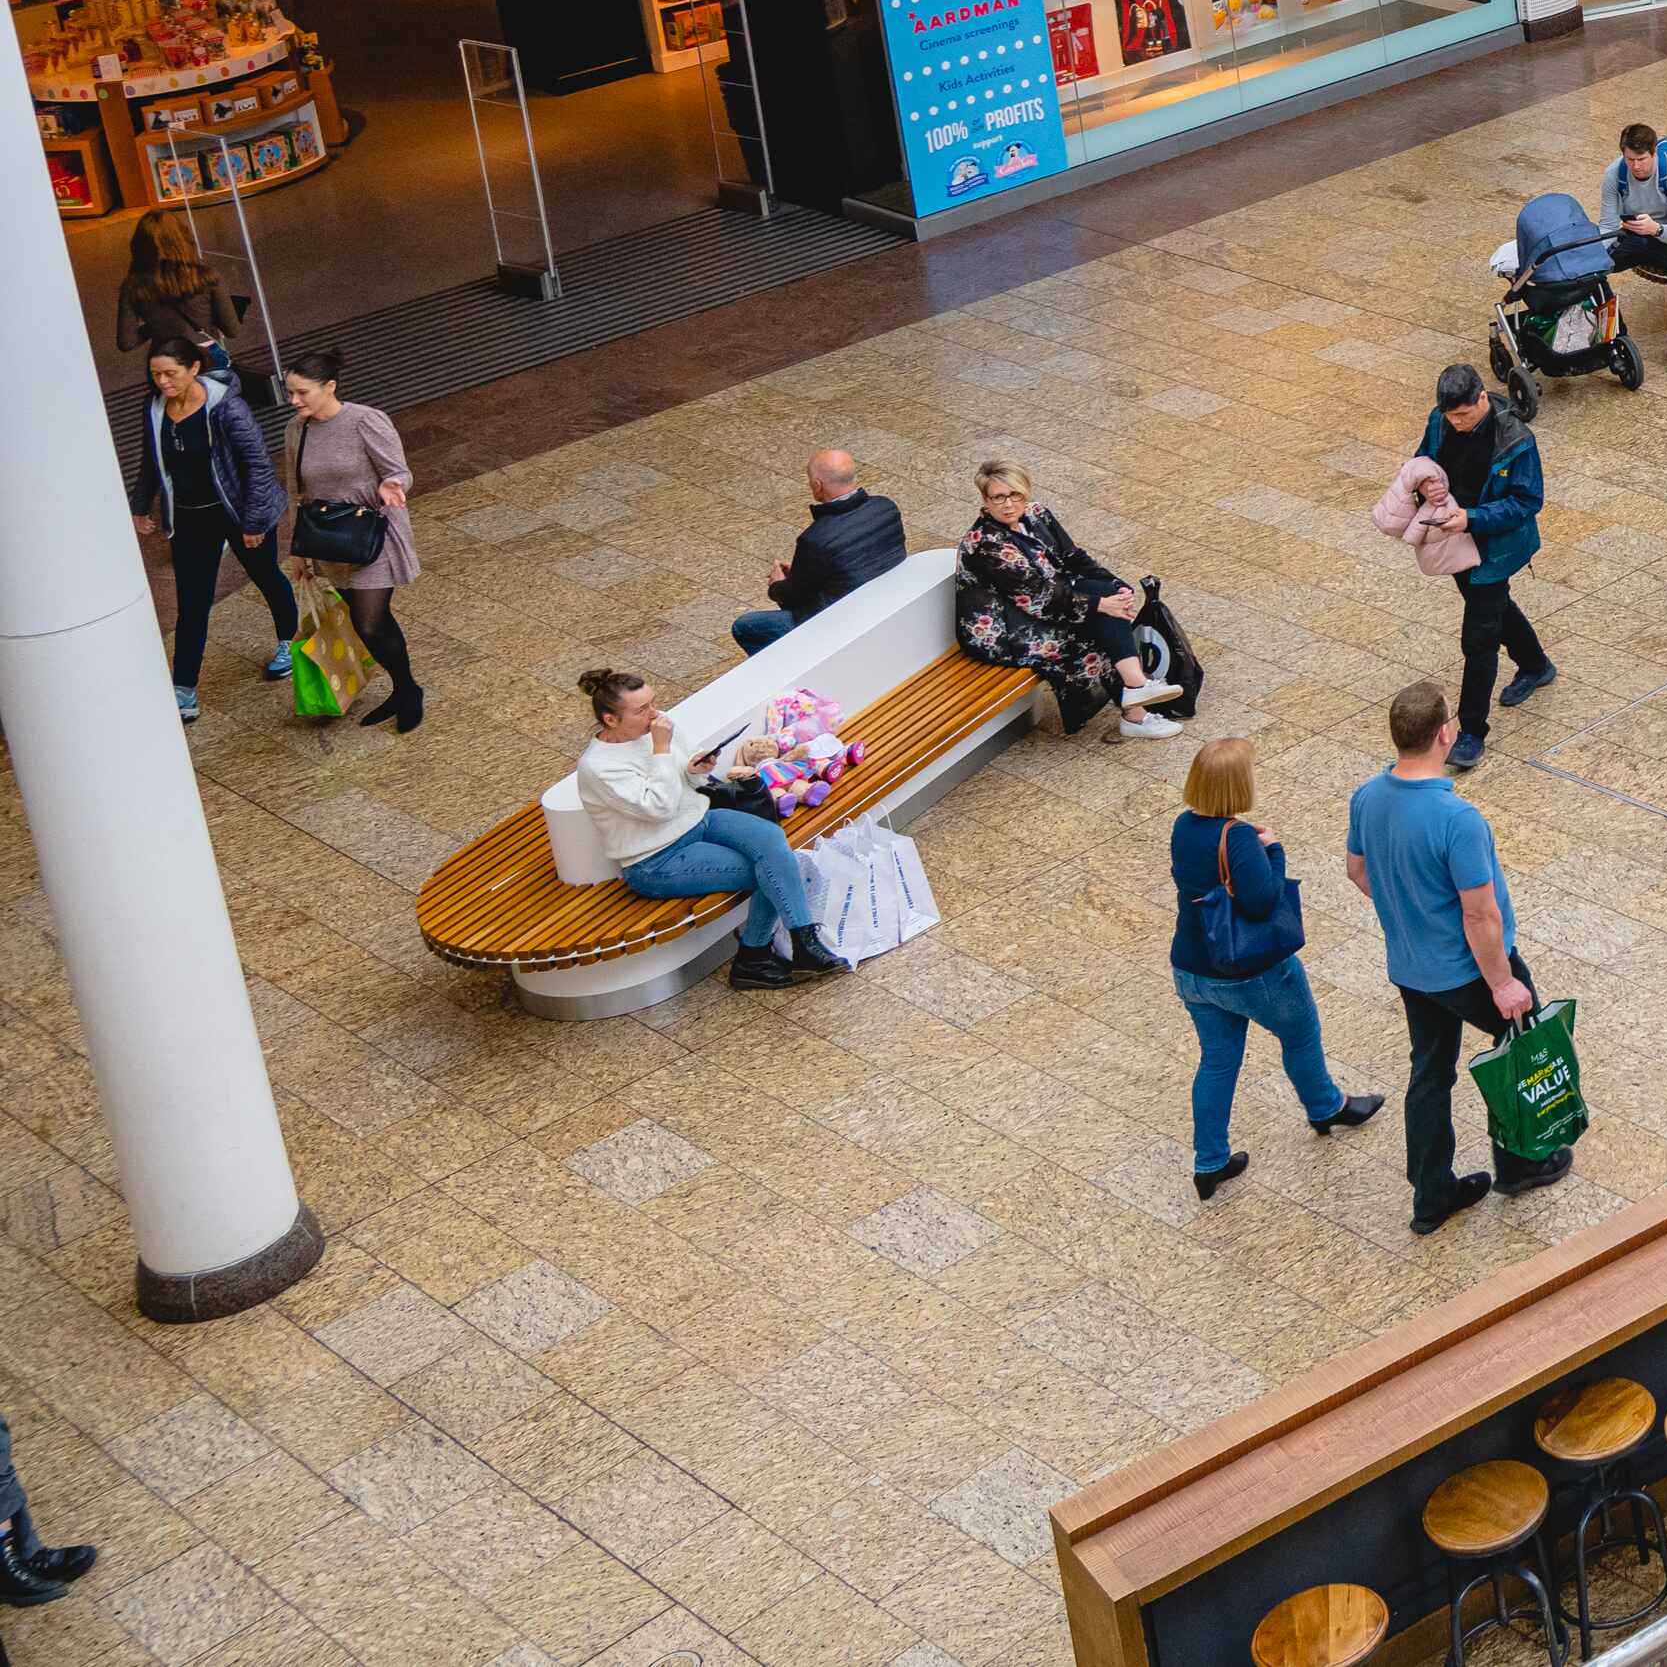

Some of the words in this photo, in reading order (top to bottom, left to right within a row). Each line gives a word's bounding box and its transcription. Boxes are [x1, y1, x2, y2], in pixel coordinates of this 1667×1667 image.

[919, 34, 962, 52] Cinema
[964, 17, 1020, 40] screenings
[939, 78, 963, 93] Kids
[965, 64, 1015, 86] Activities
[925, 120, 969, 153] 100%
[985, 97, 1045, 131] PROFITS
[972, 135, 1003, 150] support
[1522, 1064, 1571, 1104] VALUE
